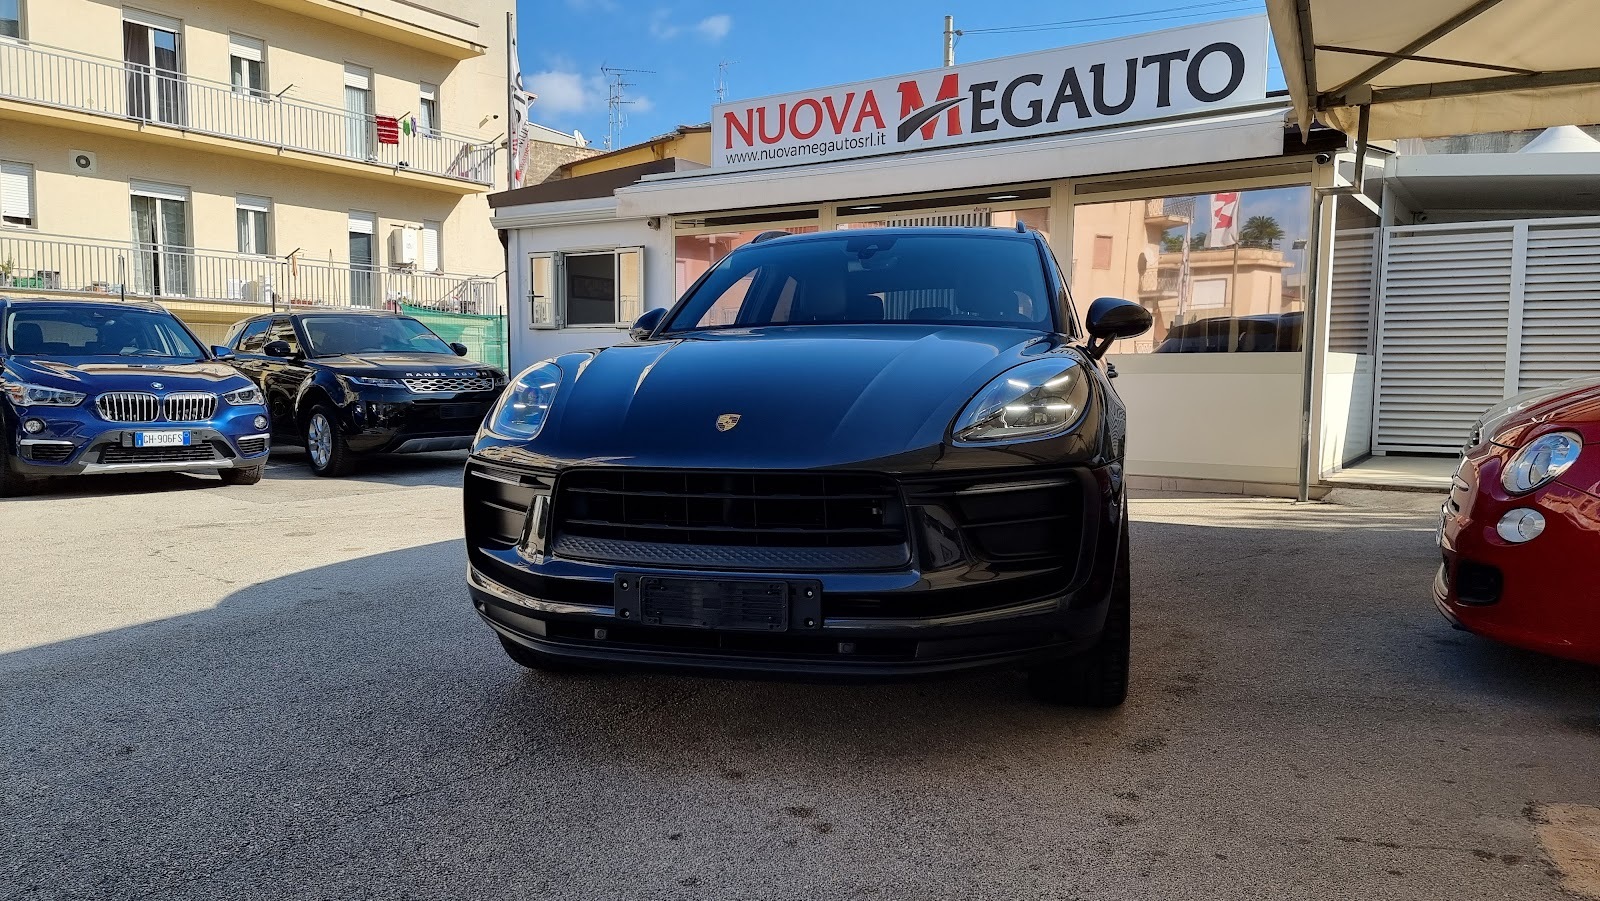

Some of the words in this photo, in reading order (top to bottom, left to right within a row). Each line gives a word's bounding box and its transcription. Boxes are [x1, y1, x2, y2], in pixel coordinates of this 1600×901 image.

[723, 89, 887, 149] NUOVA
[897, 41, 1246, 142] MEGAUTO
[725, 132, 887, 164] www.nuovamegautosrl.it
